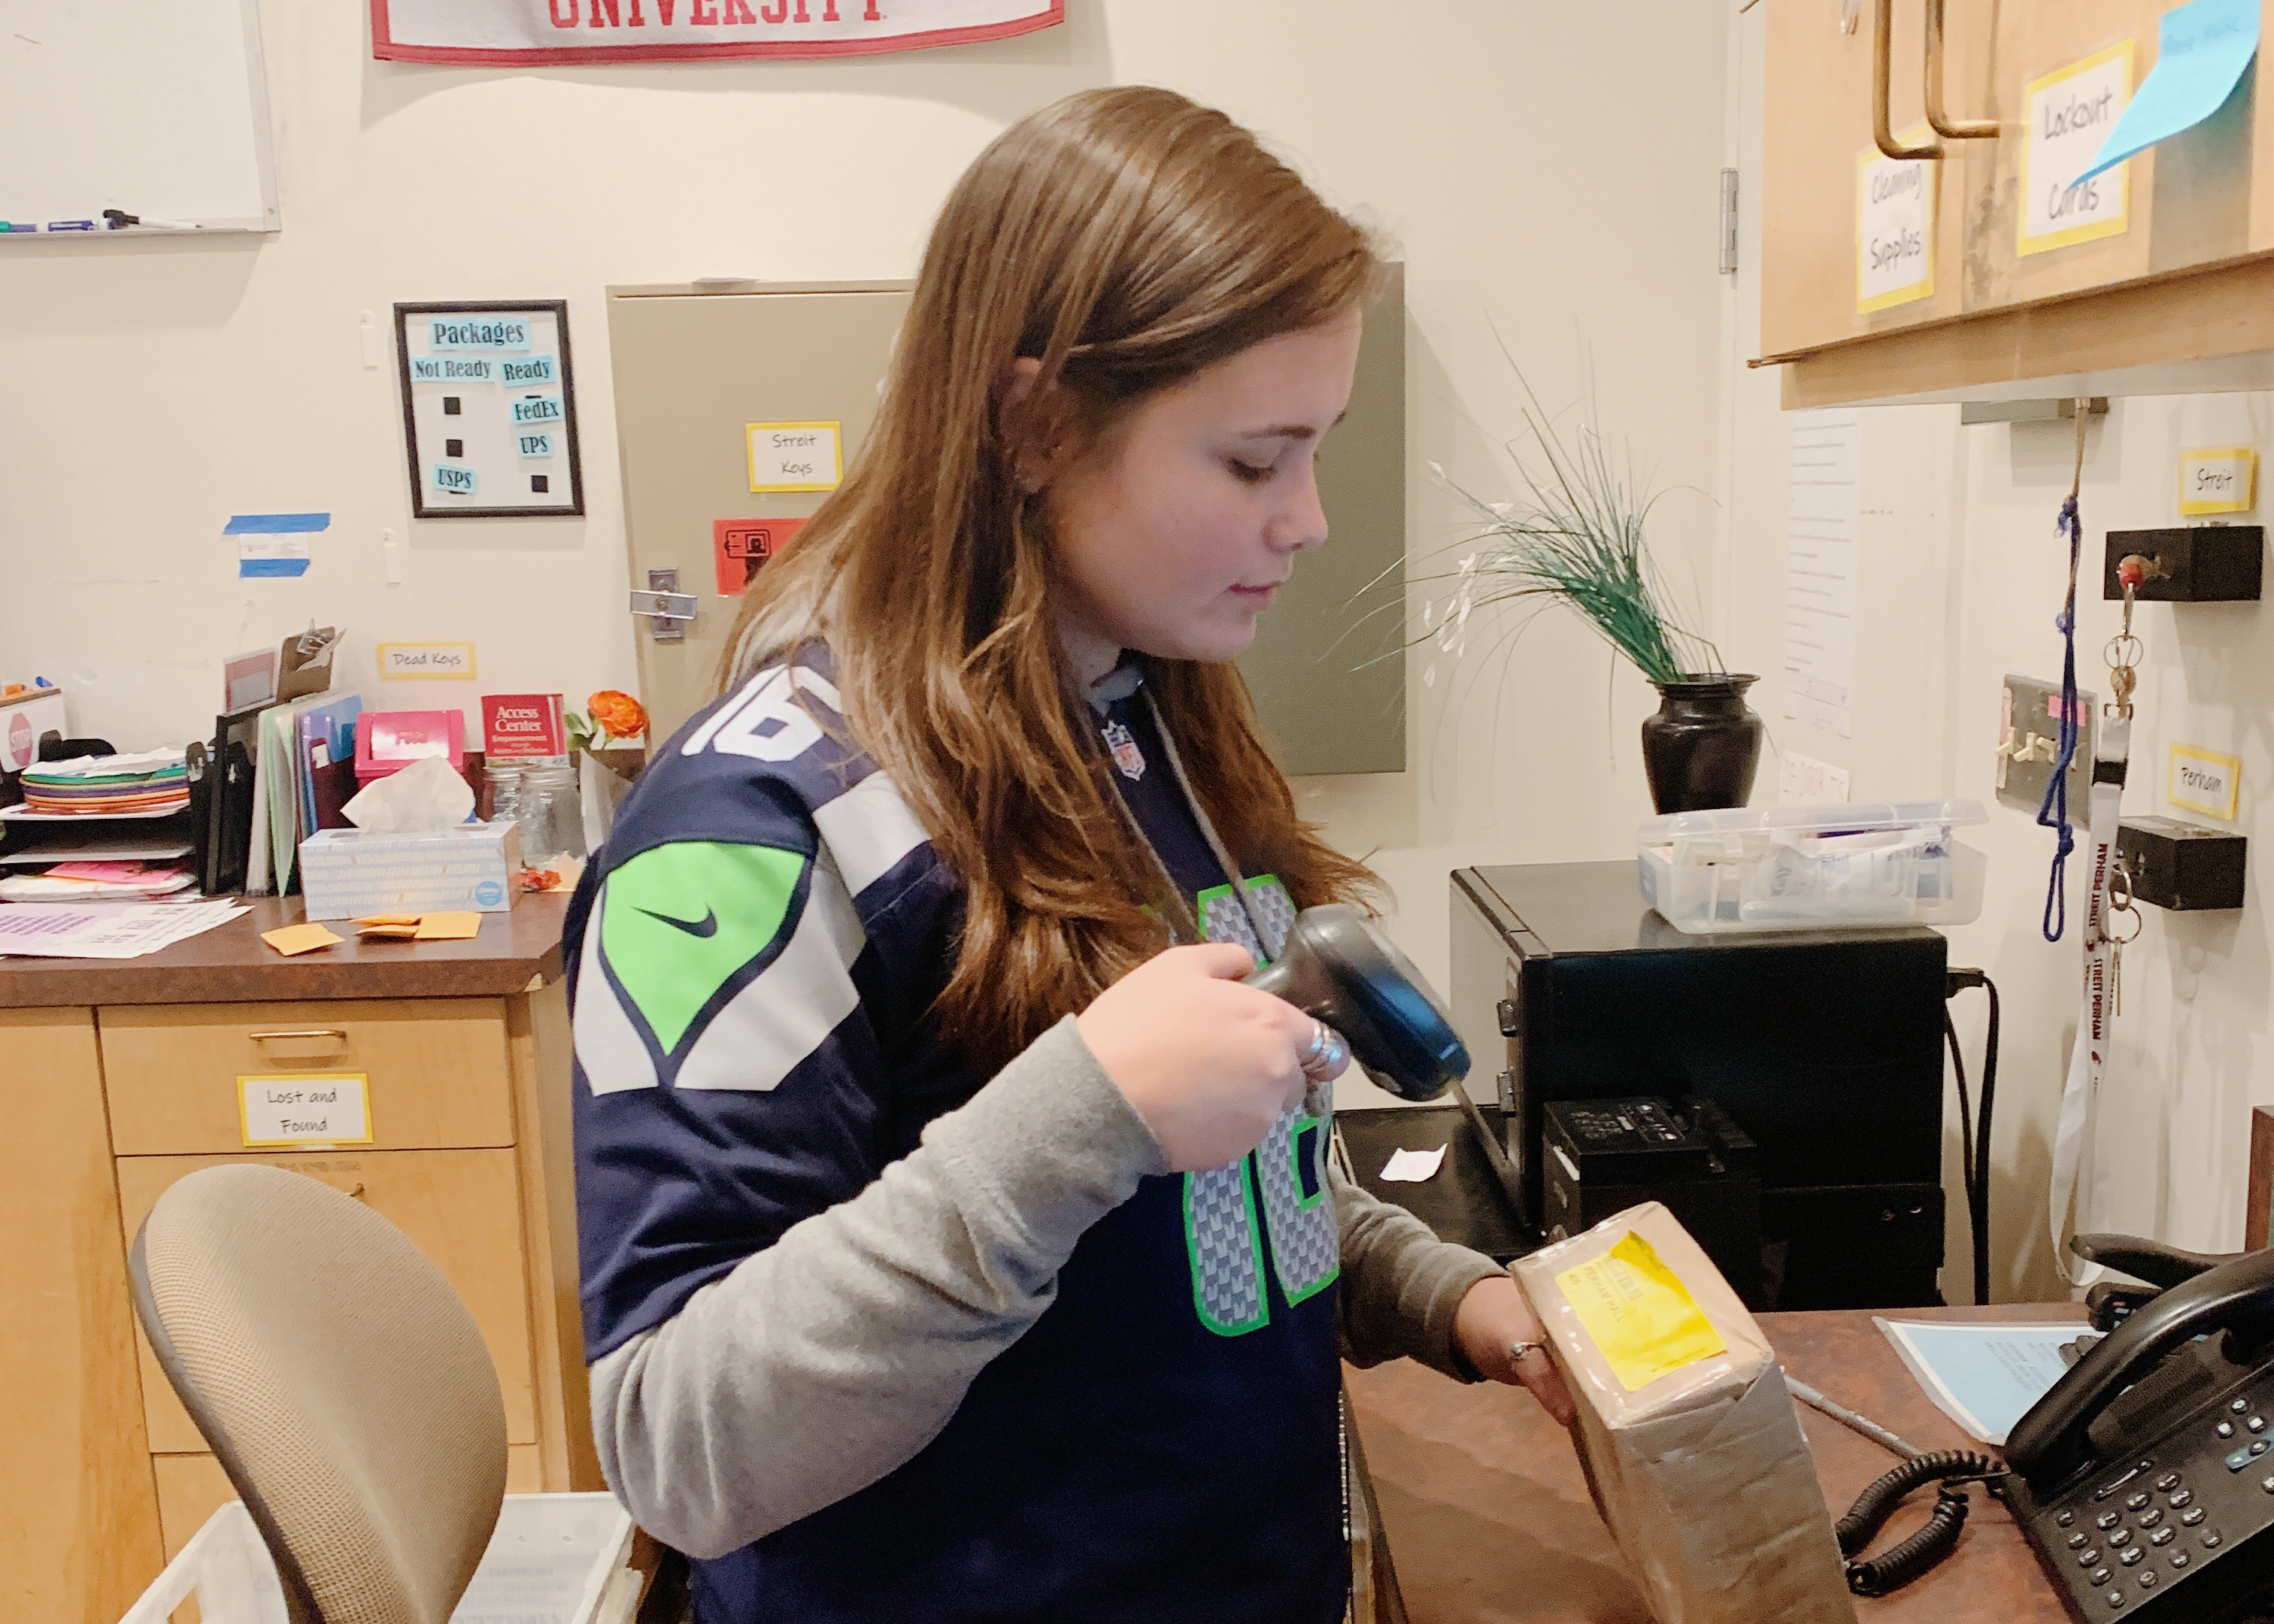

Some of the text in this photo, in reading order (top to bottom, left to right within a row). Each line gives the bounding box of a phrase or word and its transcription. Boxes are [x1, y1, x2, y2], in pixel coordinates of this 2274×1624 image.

[2044, 84, 2113, 139] Lockout
[433, 322, 524, 347] Packages
[414, 360, 492, 379] Not Ready
[503, 360, 551, 381] Ready
[514, 400, 559, 420] FedEx
[520, 435, 548, 453] UPS
[772, 434, 817, 448] Streit
[781, 460, 813, 476] Keys
[437, 468, 472, 489] USPS
[2197, 468, 2233, 491] Streit
[393, 652, 462, 668] Dead Keys
[496, 705, 540, 719] Access
[494, 719, 543, 732] Center
[2181, 767, 2222, 795] Perham
[2094, 844, 2108, 890] PERHAM
[2093, 993, 2102, 1041] PERHAM
[266, 1087, 337, 1104] Lost and
[279, 1116, 328, 1134] Found
